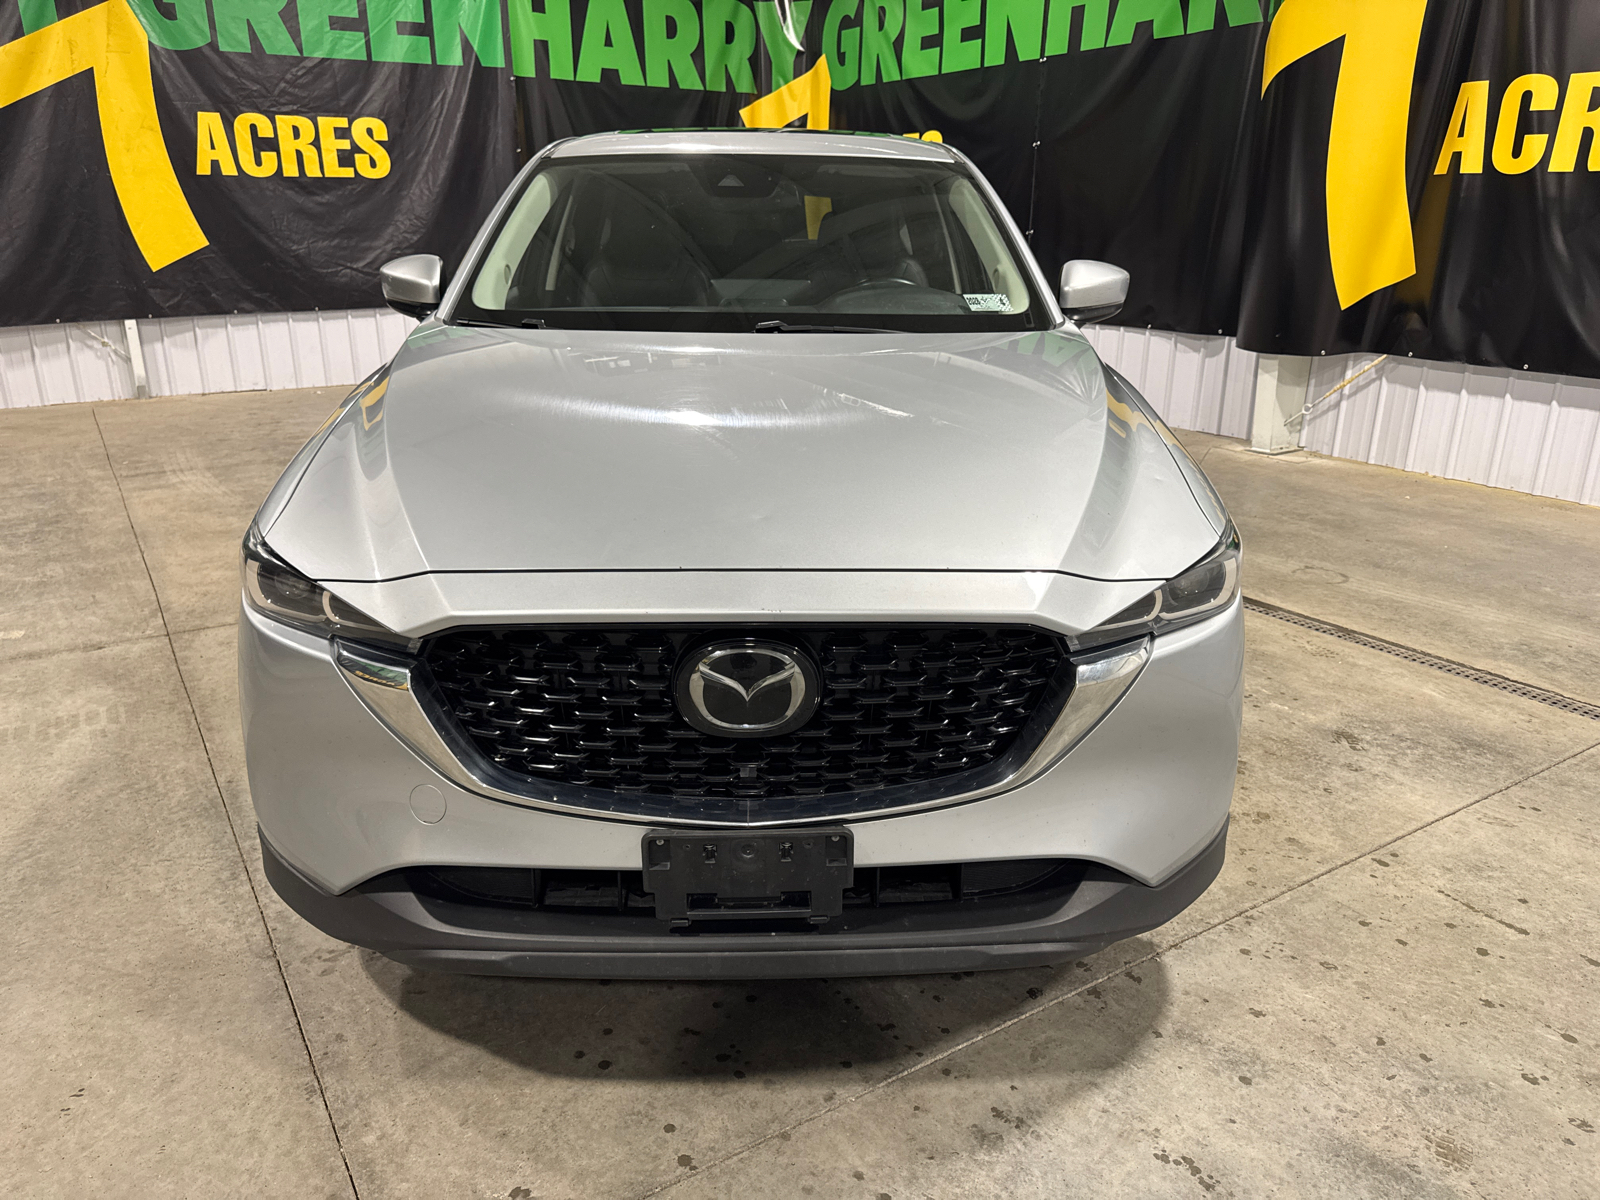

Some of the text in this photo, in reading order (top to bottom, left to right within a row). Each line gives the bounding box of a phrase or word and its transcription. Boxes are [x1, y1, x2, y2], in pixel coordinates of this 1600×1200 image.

[507, 0, 813, 94] HARRY
[822, 0, 1044, 91] GREEN
[196, 111, 391, 180] ACRES
[1261, 0, 1428, 311] 7
